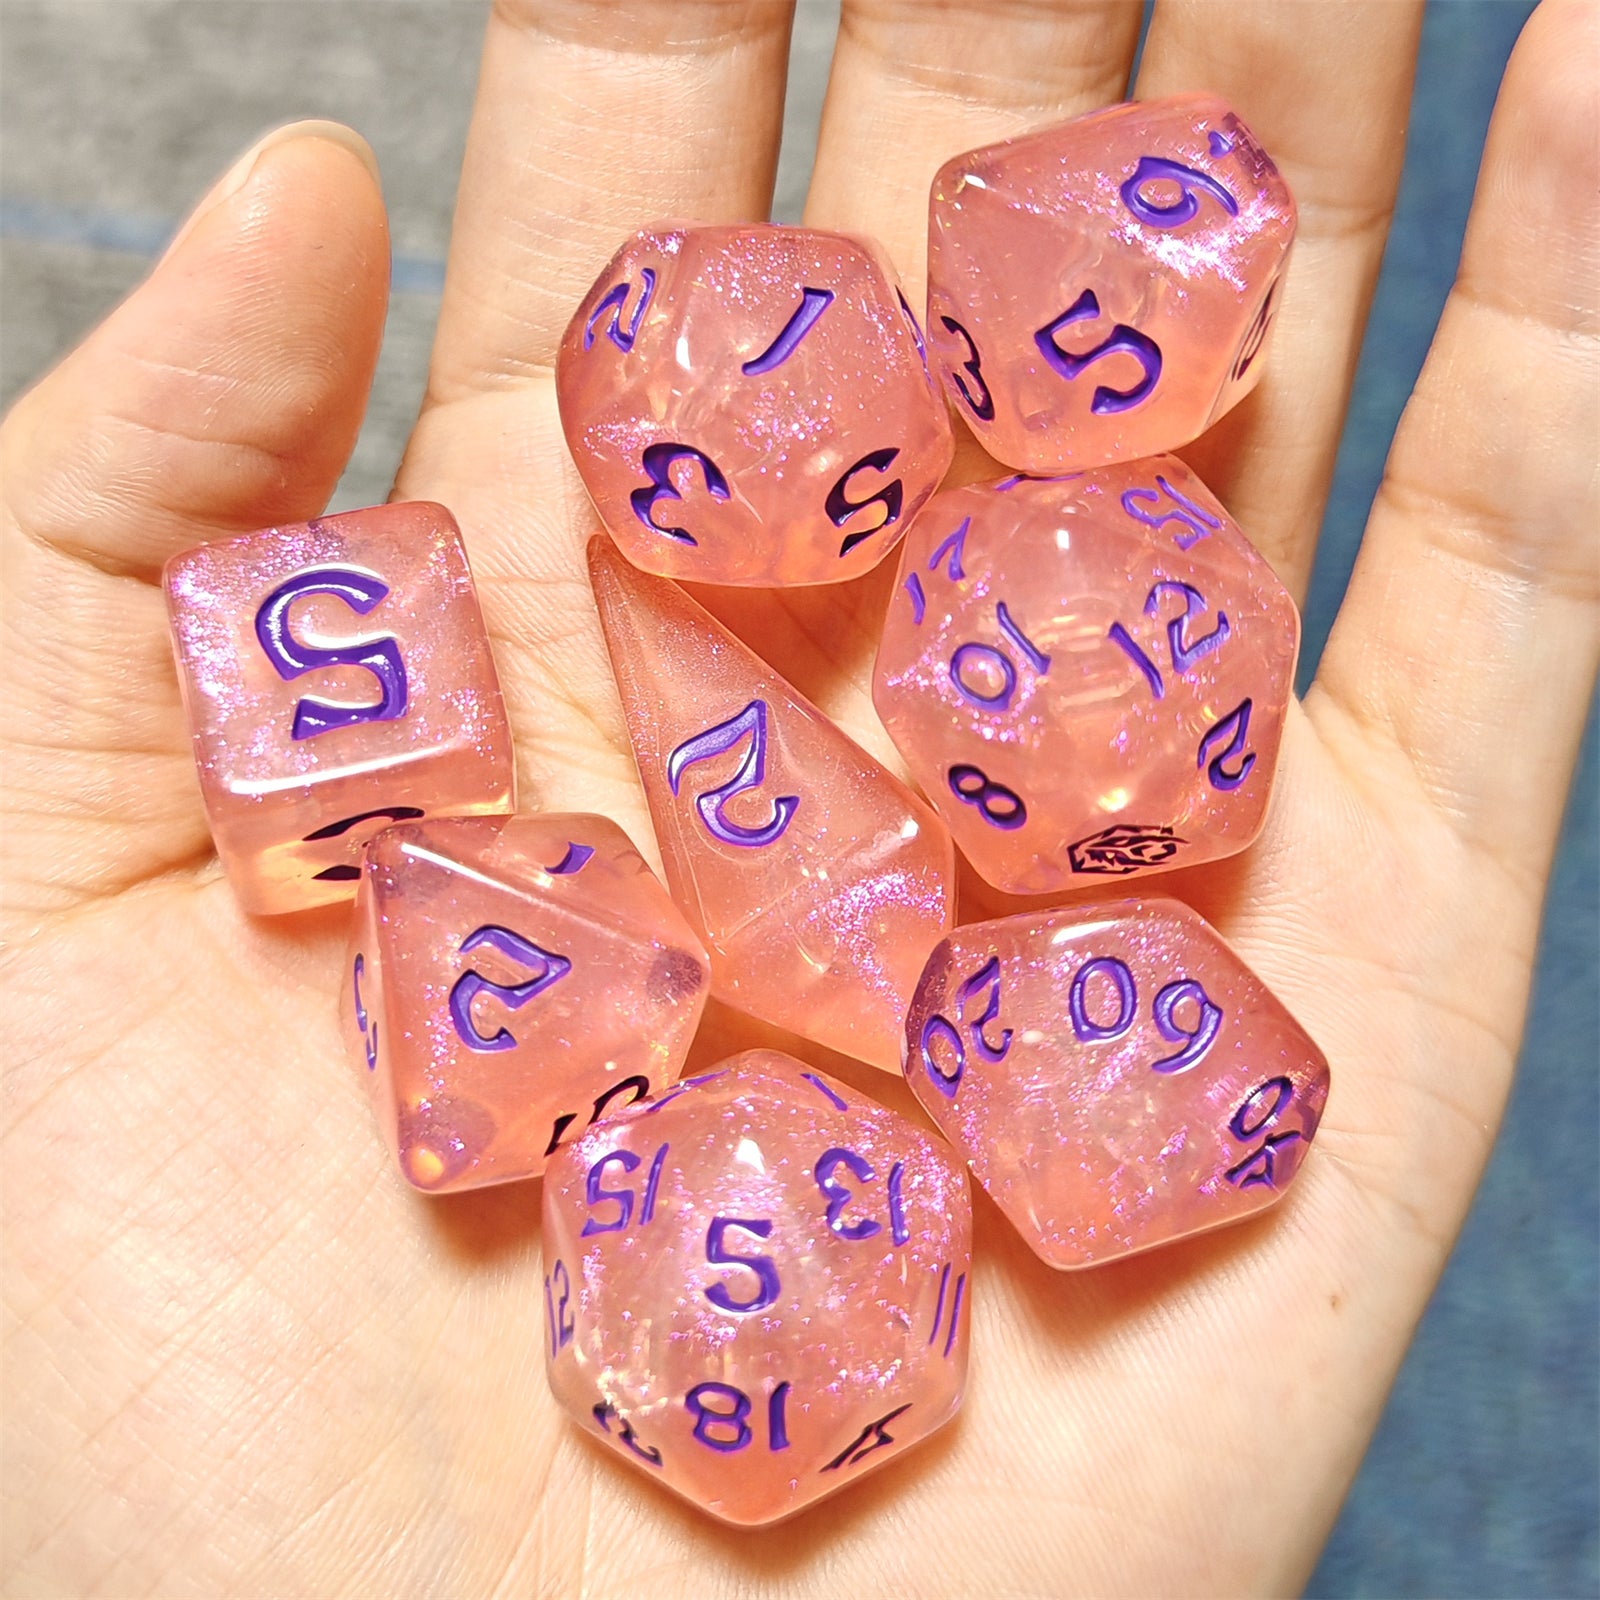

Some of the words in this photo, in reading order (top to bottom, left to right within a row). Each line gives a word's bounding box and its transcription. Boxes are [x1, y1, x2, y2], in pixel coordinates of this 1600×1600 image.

[940, 315, 994, 420] 3
[1035, 288, 1162, 414] 5
[630, 442, 730, 545] 3
[825, 448, 903, 557] 5
[255, 569, 409, 741] 5
[1109, 580, 1231, 699] 12
[668, 699, 801, 848] 2
[948, 765, 1026, 829] 8
[1198, 698, 1256, 791] 2
[449, 925, 572, 1052] 2
[705, 1216, 782, 1313] 5
